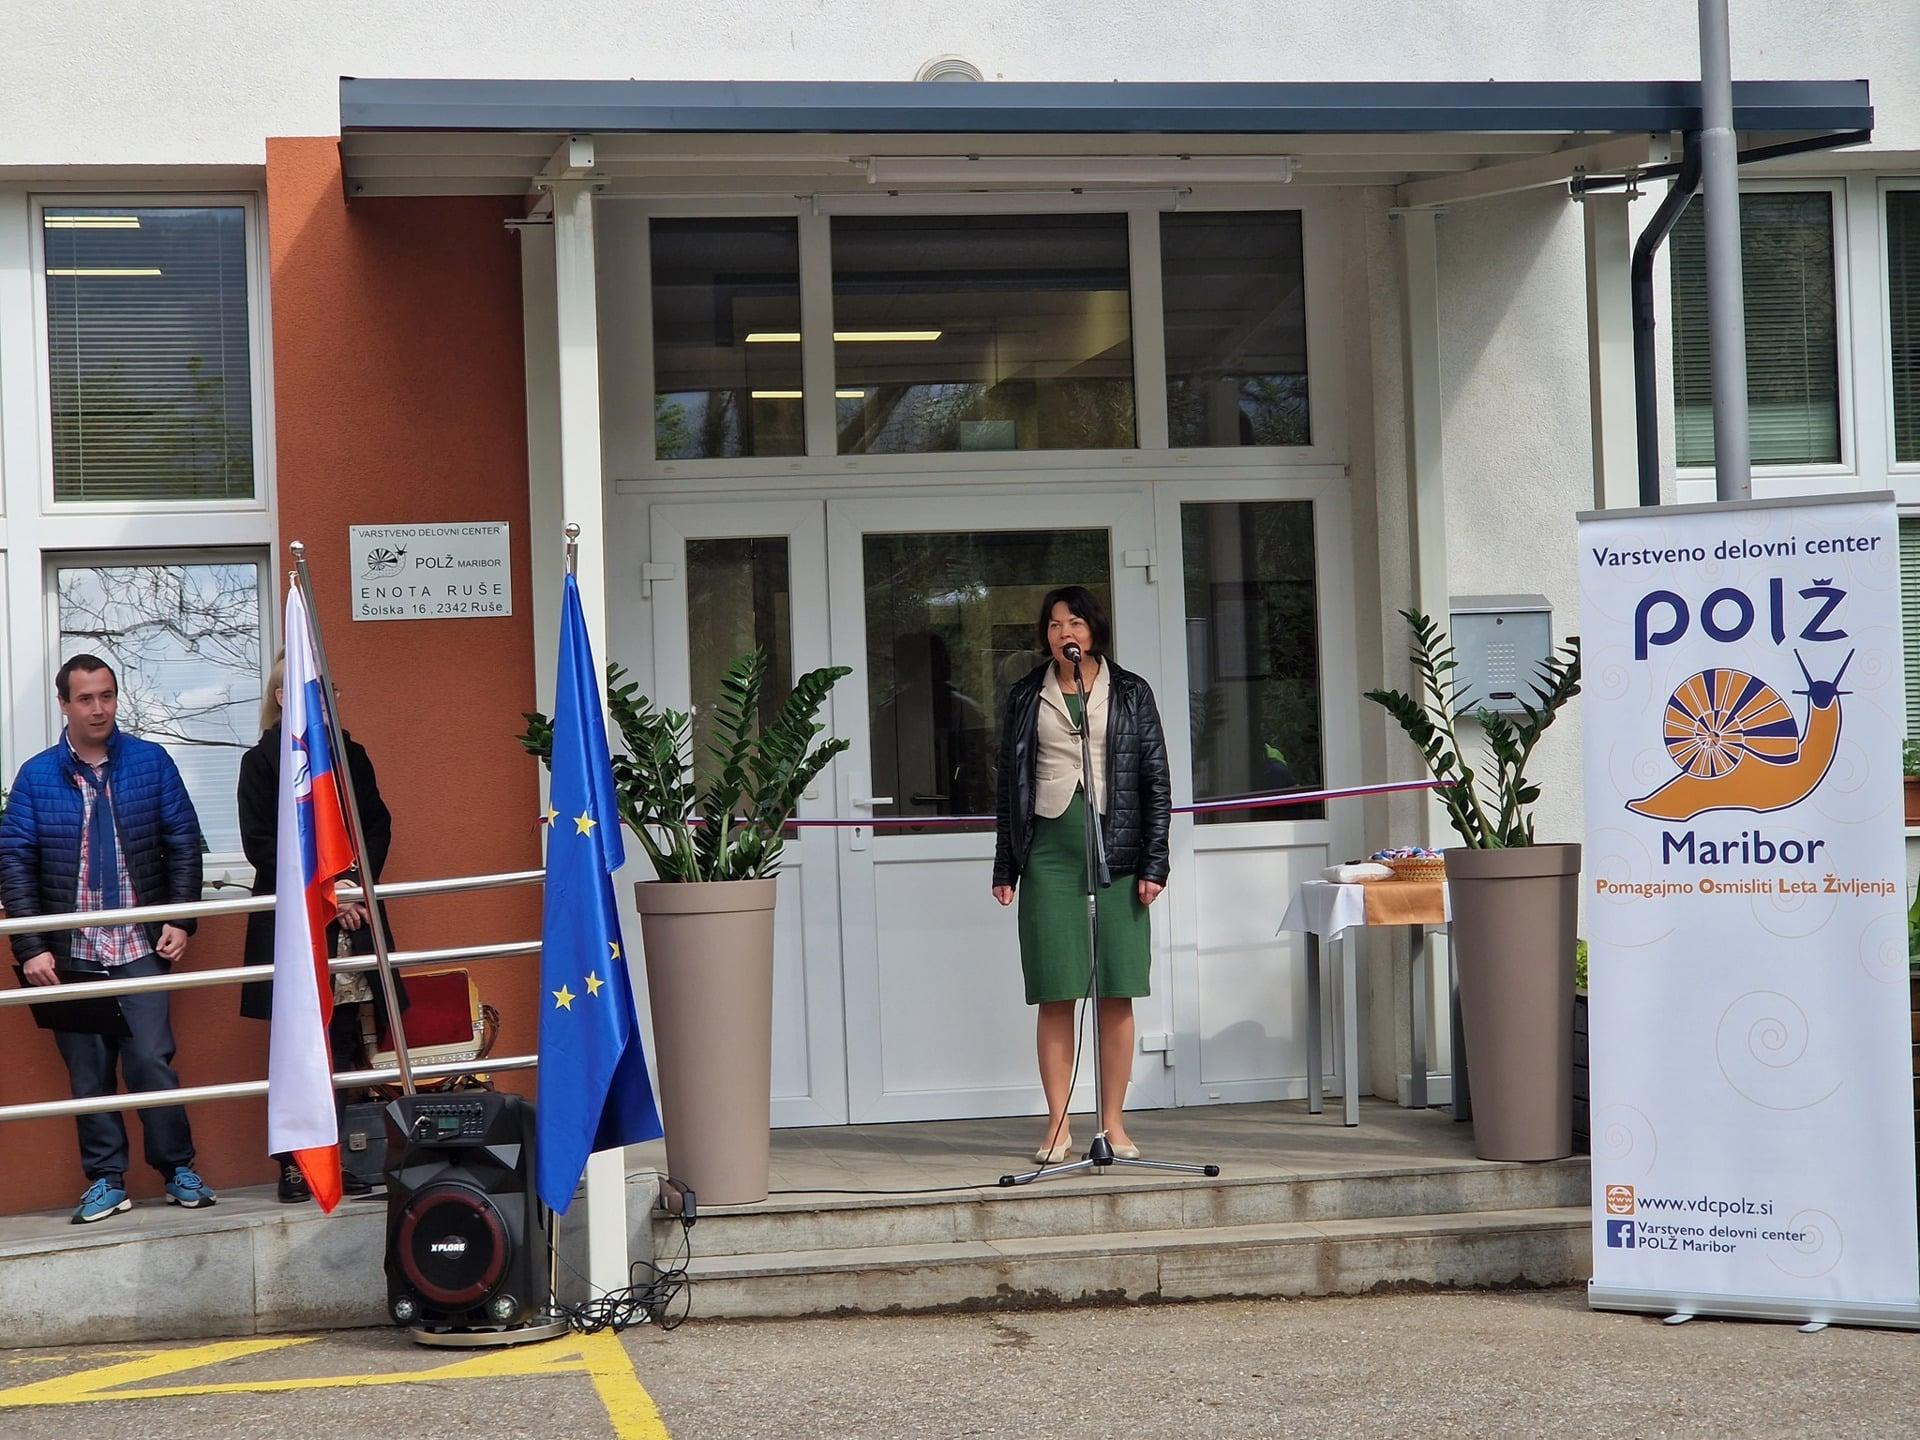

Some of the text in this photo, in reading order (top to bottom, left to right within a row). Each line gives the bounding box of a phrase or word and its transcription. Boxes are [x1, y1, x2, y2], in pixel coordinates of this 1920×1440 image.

[358, 527, 500, 538] VARSTVENO DELOVNI CENTER
[1592, 535, 1881, 567] Varstveno delovni center
[415, 554, 501, 569] POLŽ MARIBOR
[361, 582, 502, 599] ENOTA RUŠE
[361, 604, 404, 615] Šolska
[437, 602, 467, 613] 2342
[471, 601, 503, 612] Ruše
[1634, 577, 1849, 661] polž
[1662, 830, 1825, 864] Maribor
[1595, 874, 1896, 898] Pomagajmo Osmisliti Leta Življenja
[1637, 1195, 1774, 1217] www.vdcpolz.si
[1638, 1222, 1806, 1242] Varstveno delovni center
[1638, 1235, 1737, 1253] POLŽ Maribor
